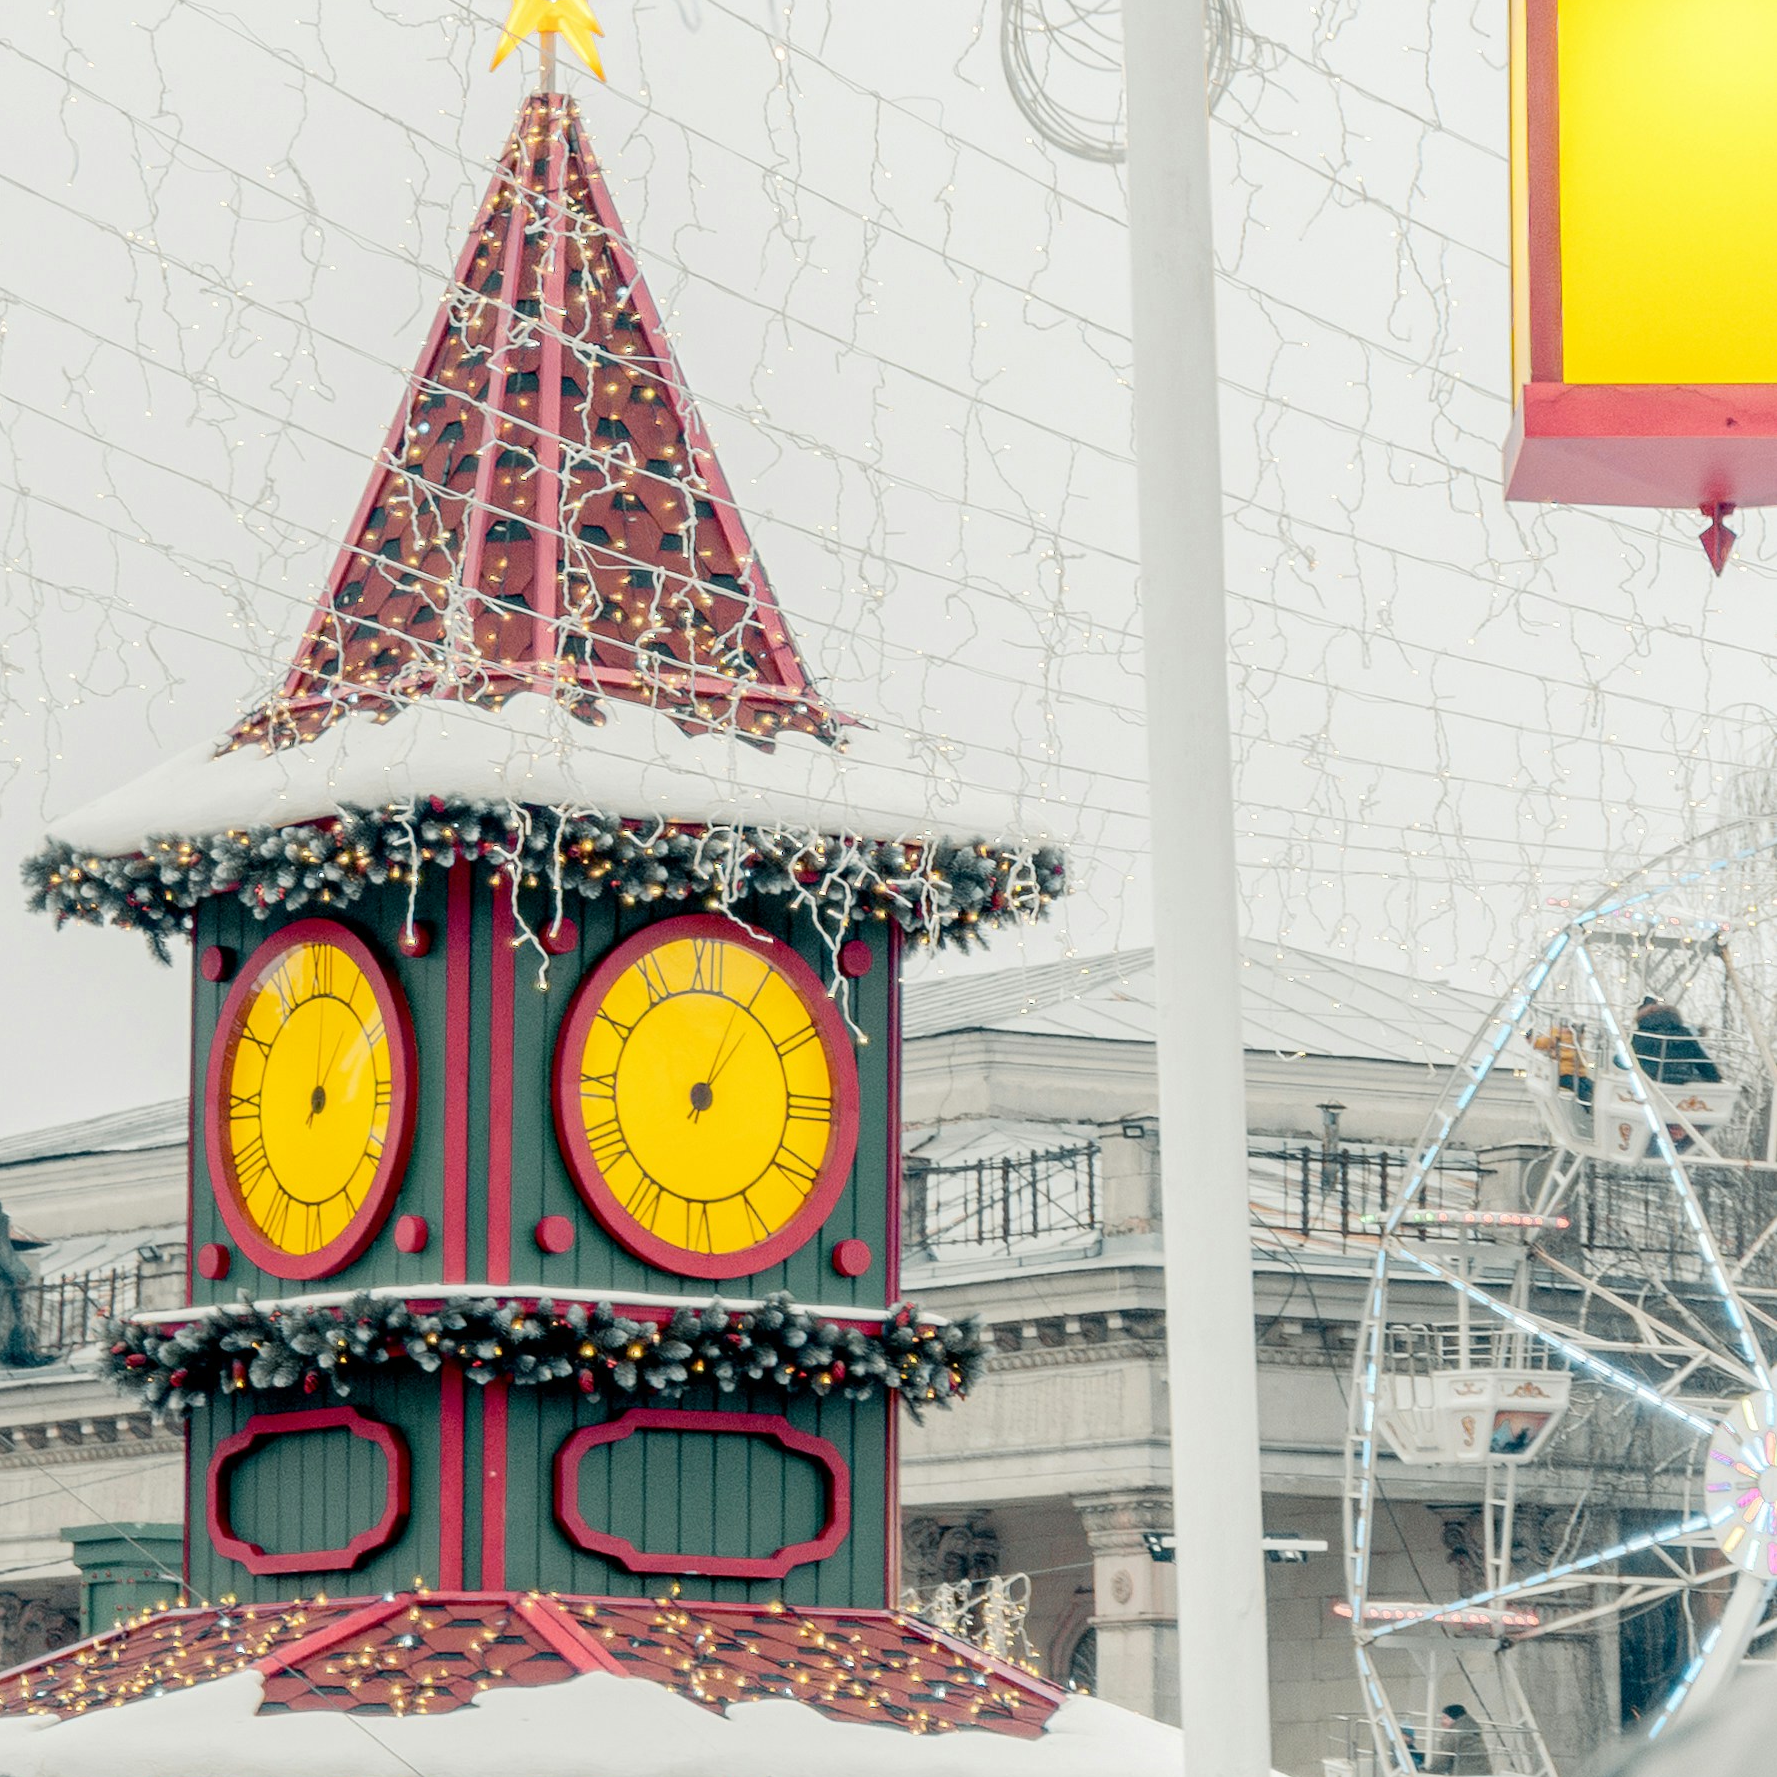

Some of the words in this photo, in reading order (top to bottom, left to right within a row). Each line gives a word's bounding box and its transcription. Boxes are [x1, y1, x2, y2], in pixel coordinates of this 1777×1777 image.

[689, 938, 724, 993] XII
[594, 1005, 636, 1042] X
[774, 1022, 819, 1057] II
[785, 1092, 832, 1122] III
[771, 1144, 820, 1198] IV
[740, 1190, 772, 1245] V
